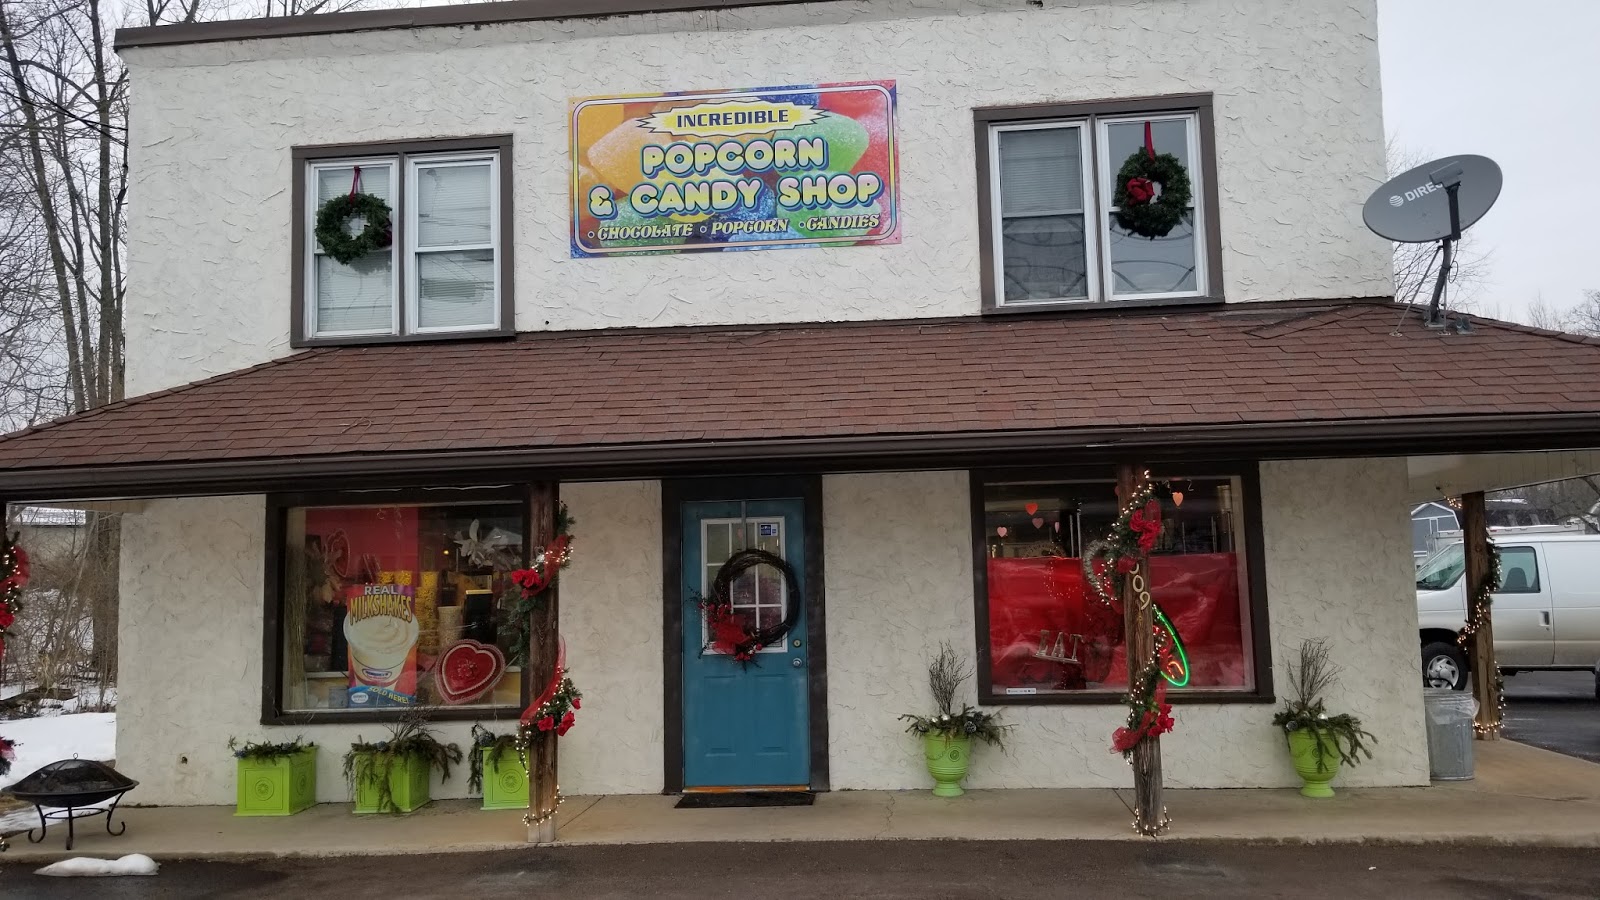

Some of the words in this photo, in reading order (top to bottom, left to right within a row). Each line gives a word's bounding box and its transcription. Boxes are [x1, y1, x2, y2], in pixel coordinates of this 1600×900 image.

[676, 109, 789, 128] INCREDIBLE
[641, 137, 829, 179] POPCORN
[588, 185, 618, 219] &
[630, 178, 764, 219] CANDY
[777, 173, 885, 211] SHOP
[597, 223, 693, 241] CHOCOLATE
[711, 219, 789, 235] POPCORN
[806, 214, 880, 231] CANDIES
[364, 585, 399, 595] REAL
[350, 595, 413, 626] MILKSHAKES
[368, 686, 388, 697] SOLD
[388, 692, 410, 704] HERE!
